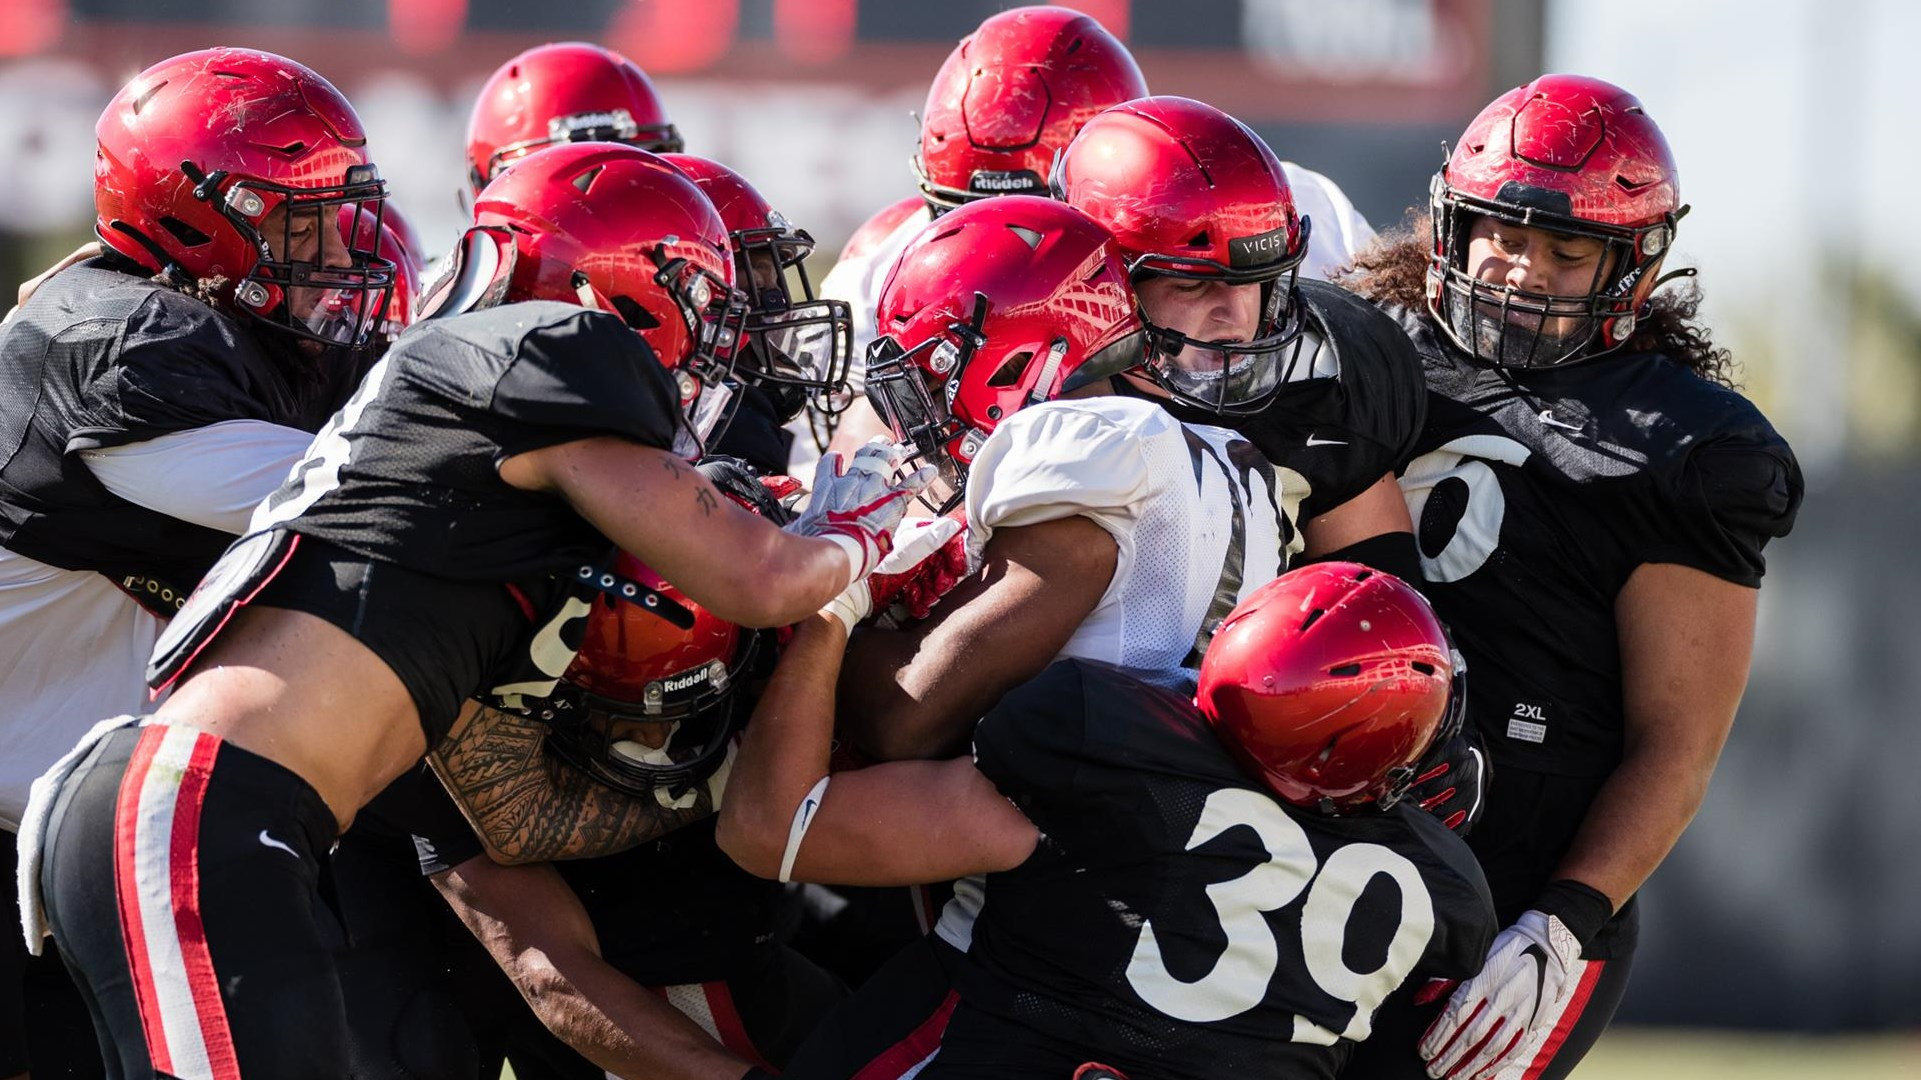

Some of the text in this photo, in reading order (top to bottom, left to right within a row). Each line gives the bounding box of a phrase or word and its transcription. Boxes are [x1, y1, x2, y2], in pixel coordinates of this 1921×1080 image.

[1243, 234, 1280, 254] VICIS
[664, 667, 708, 693] Riddell
[1514, 703, 1546, 721] 2XL
[1125, 788, 1435, 1046] 39
